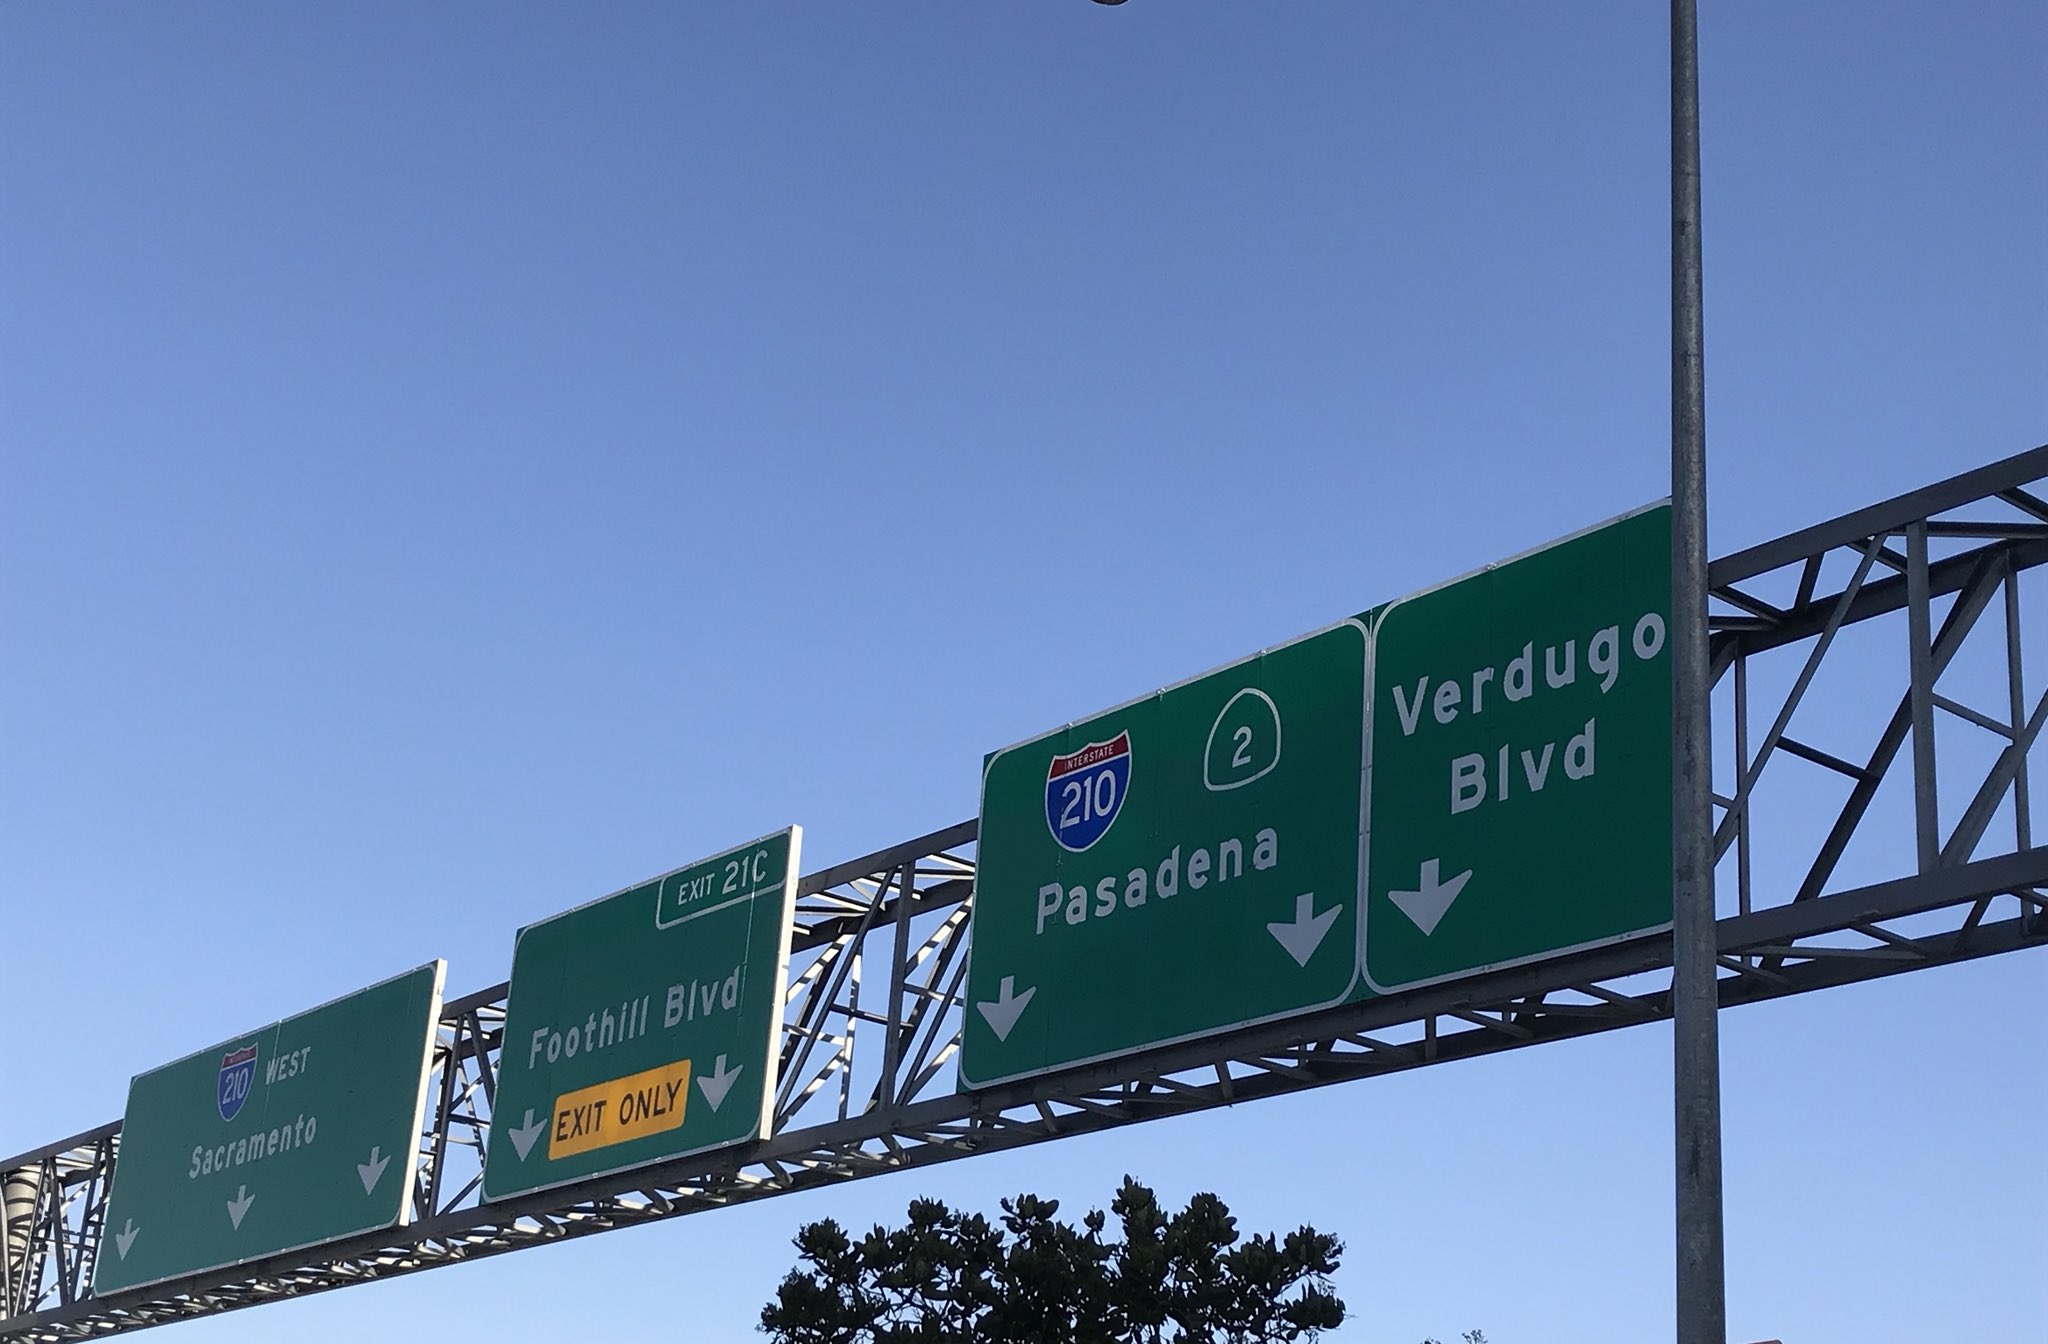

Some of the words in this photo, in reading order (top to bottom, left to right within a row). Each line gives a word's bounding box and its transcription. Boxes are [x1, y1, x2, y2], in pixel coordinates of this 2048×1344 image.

[1392, 612, 1666, 737] Verdugo
[1064, 745, 1115, 770] INTERSTATE
[1232, 726, 1252, 768] 2
[1451, 717, 1596, 815] Blvd
[1060, 770, 1116, 829] 210
[677, 872, 716, 907] EXIT
[722, 850, 769, 895] 21C
[1036, 827, 1278, 935] Pasadena
[529, 994, 650, 1070] Foothill
[663, 965, 741, 1029] Blvd
[222, 1067, 249, 1104] 210
[265, 1046, 312, 1085] WEST
[556, 1100, 607, 1143] EXIT
[619, 1077, 684, 1126] ONLY
[189, 1113, 318, 1180] Sacramento
